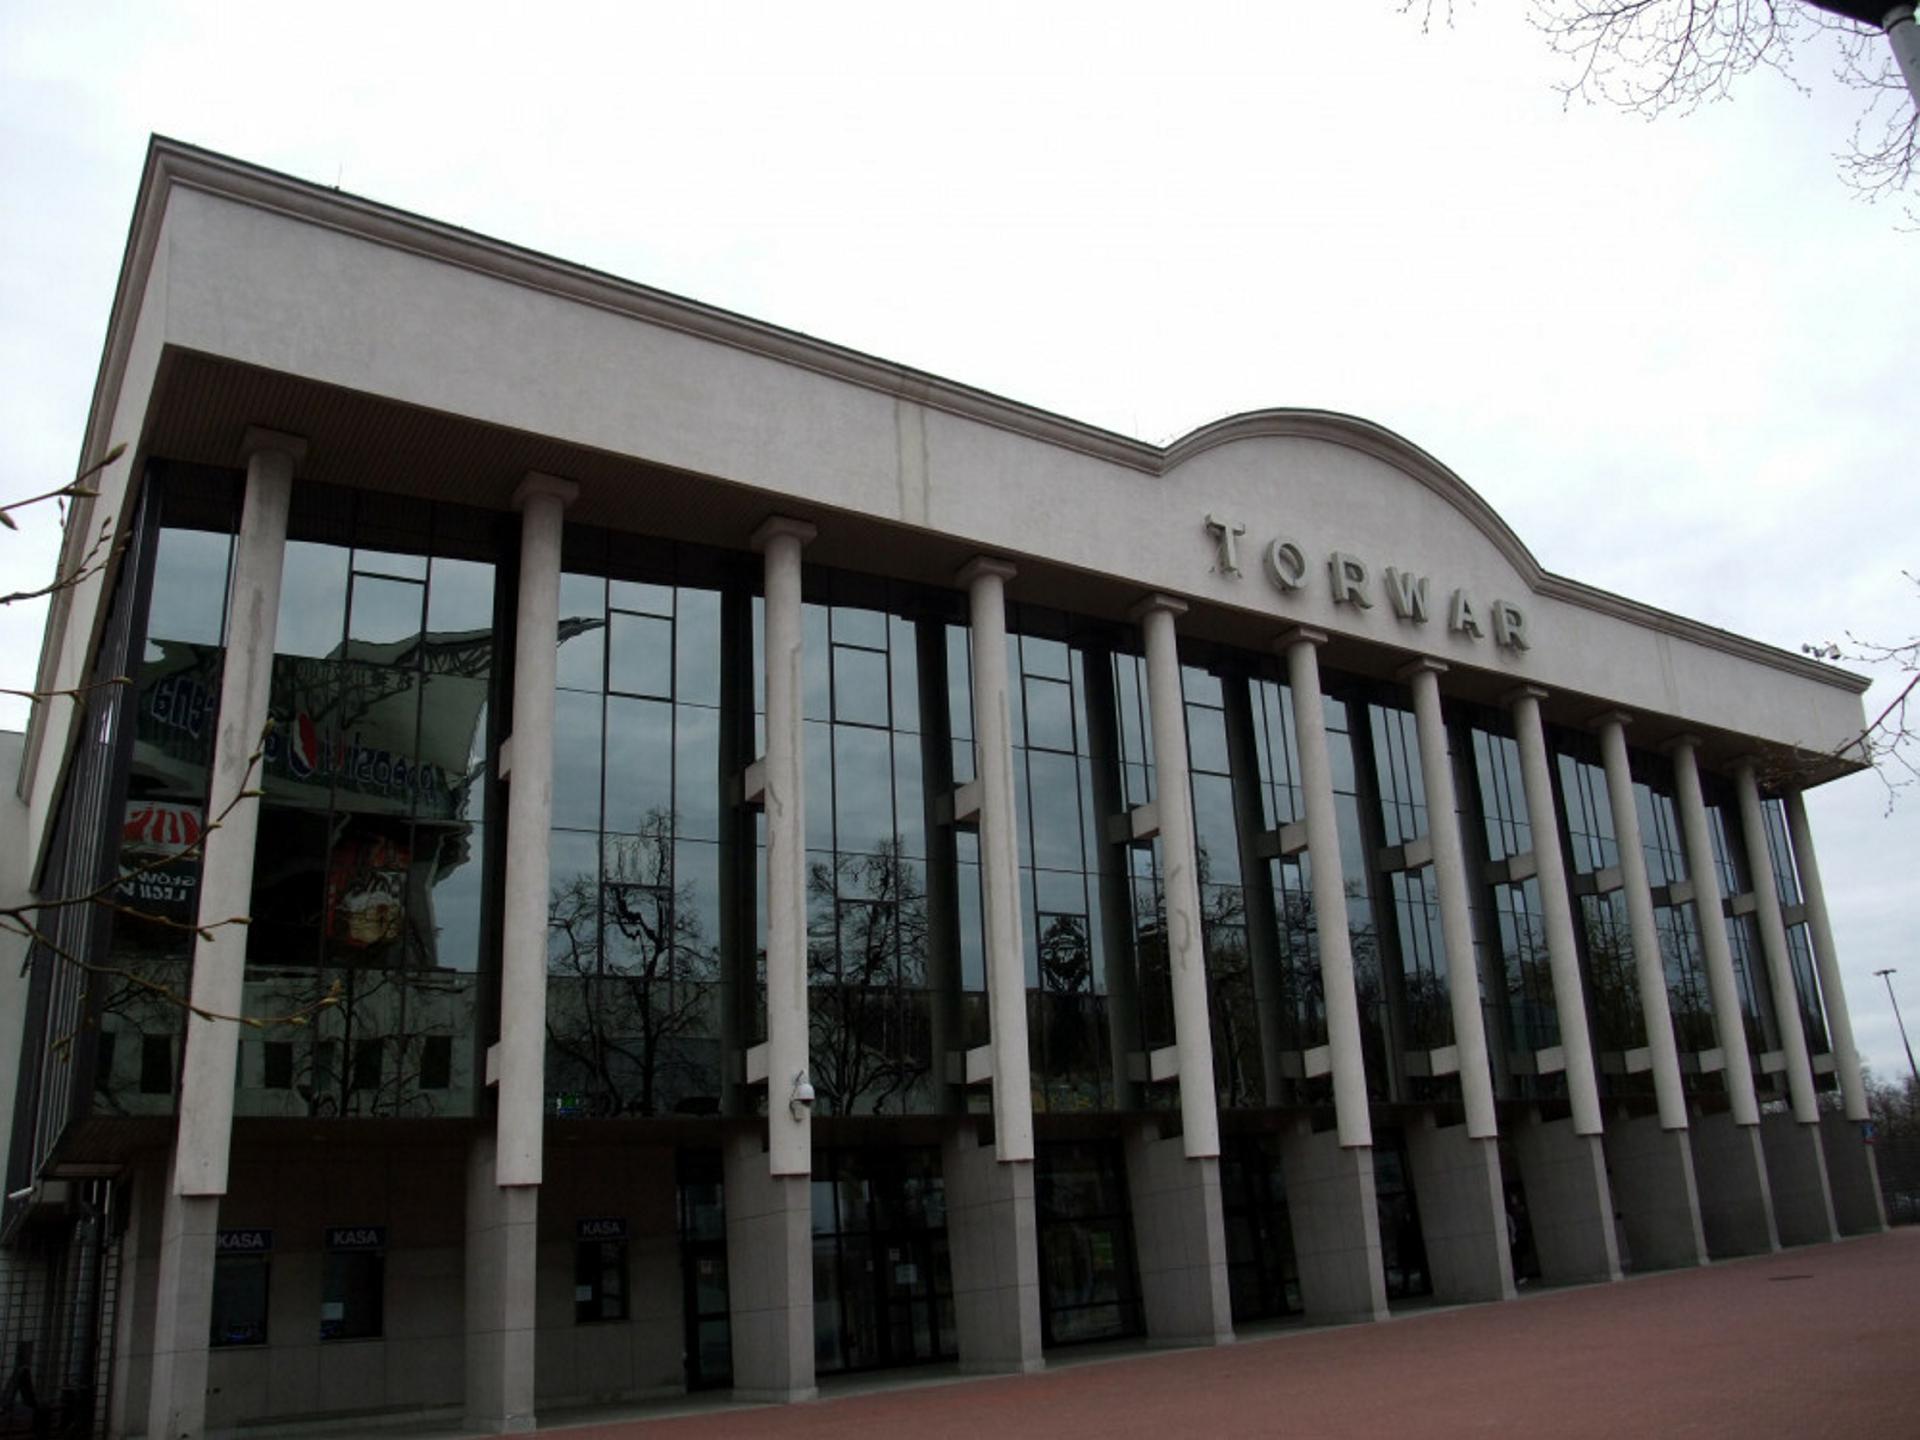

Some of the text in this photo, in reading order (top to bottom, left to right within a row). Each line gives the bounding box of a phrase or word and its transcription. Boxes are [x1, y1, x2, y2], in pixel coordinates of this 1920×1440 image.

[1204, 514, 1530, 651] TORWAR
[582, 1219, 620, 1235] KASA
[217, 1231, 265, 1248] KASA
[332, 1229, 378, 1245] KASA
